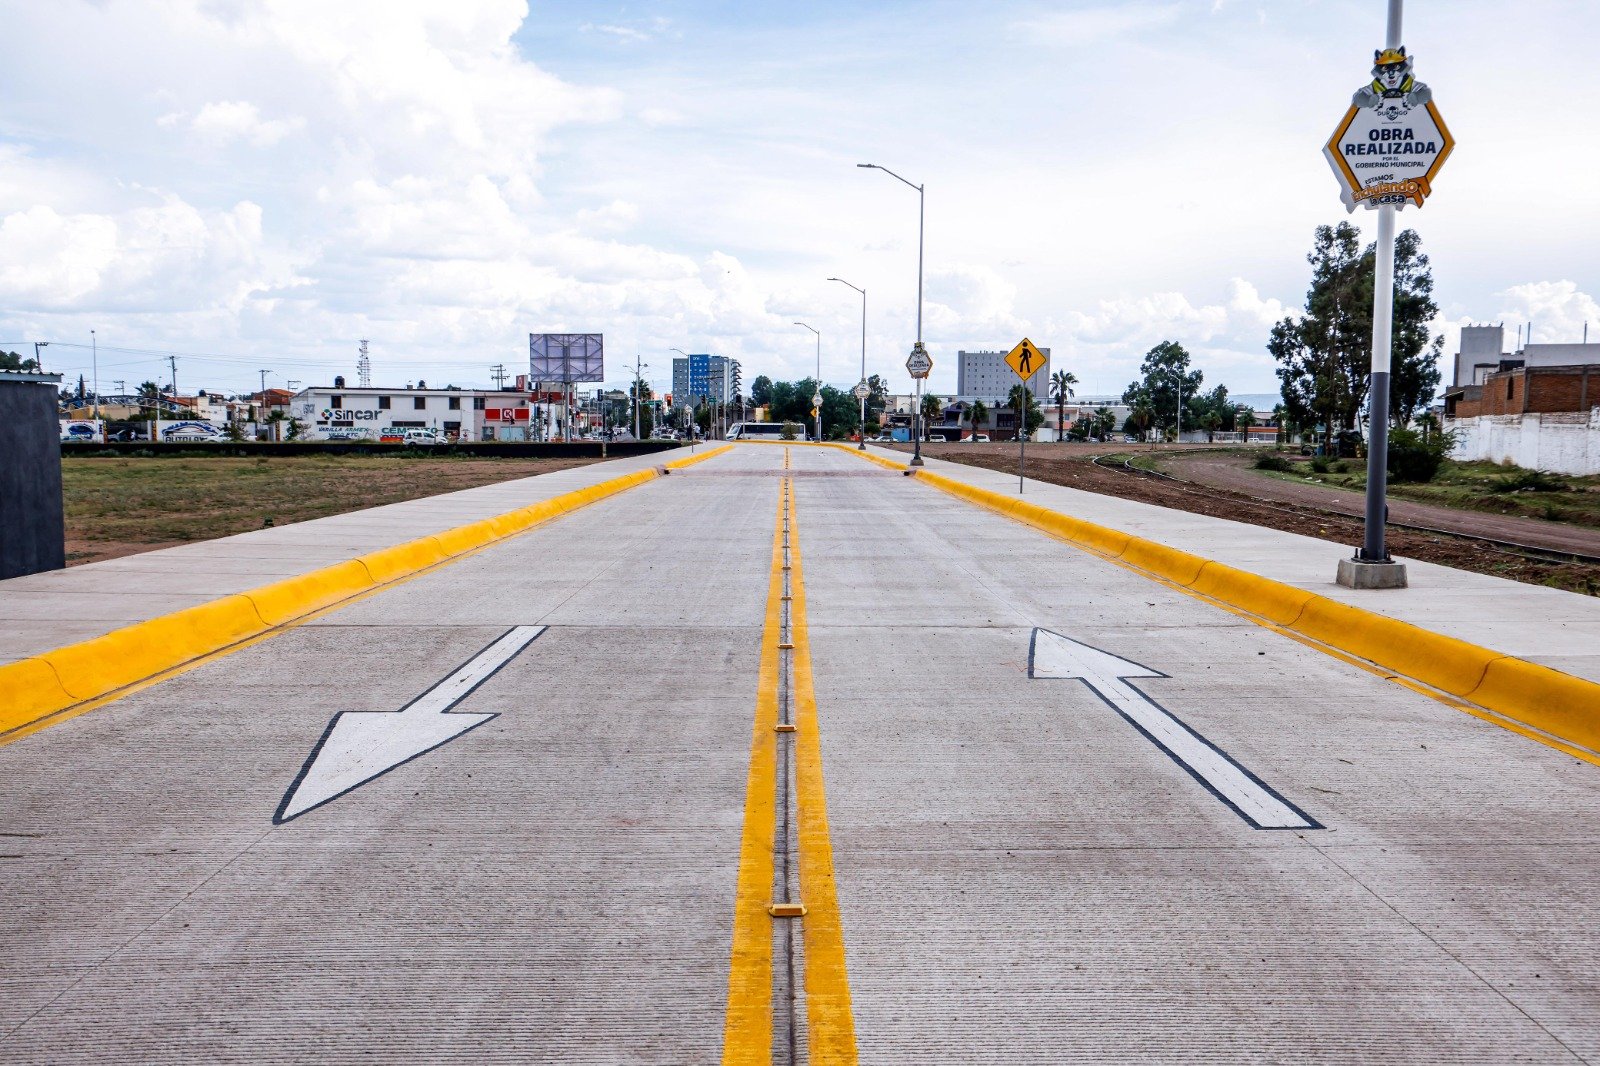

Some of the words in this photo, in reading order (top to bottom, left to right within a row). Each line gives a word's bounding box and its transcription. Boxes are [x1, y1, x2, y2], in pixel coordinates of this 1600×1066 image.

[1369, 128, 1414, 141] OBRA
[1345, 142, 1436, 155] REALIZADA
[1365, 173, 1394, 184] ESTAMOS
[1379, 193, 1406, 204] casa
